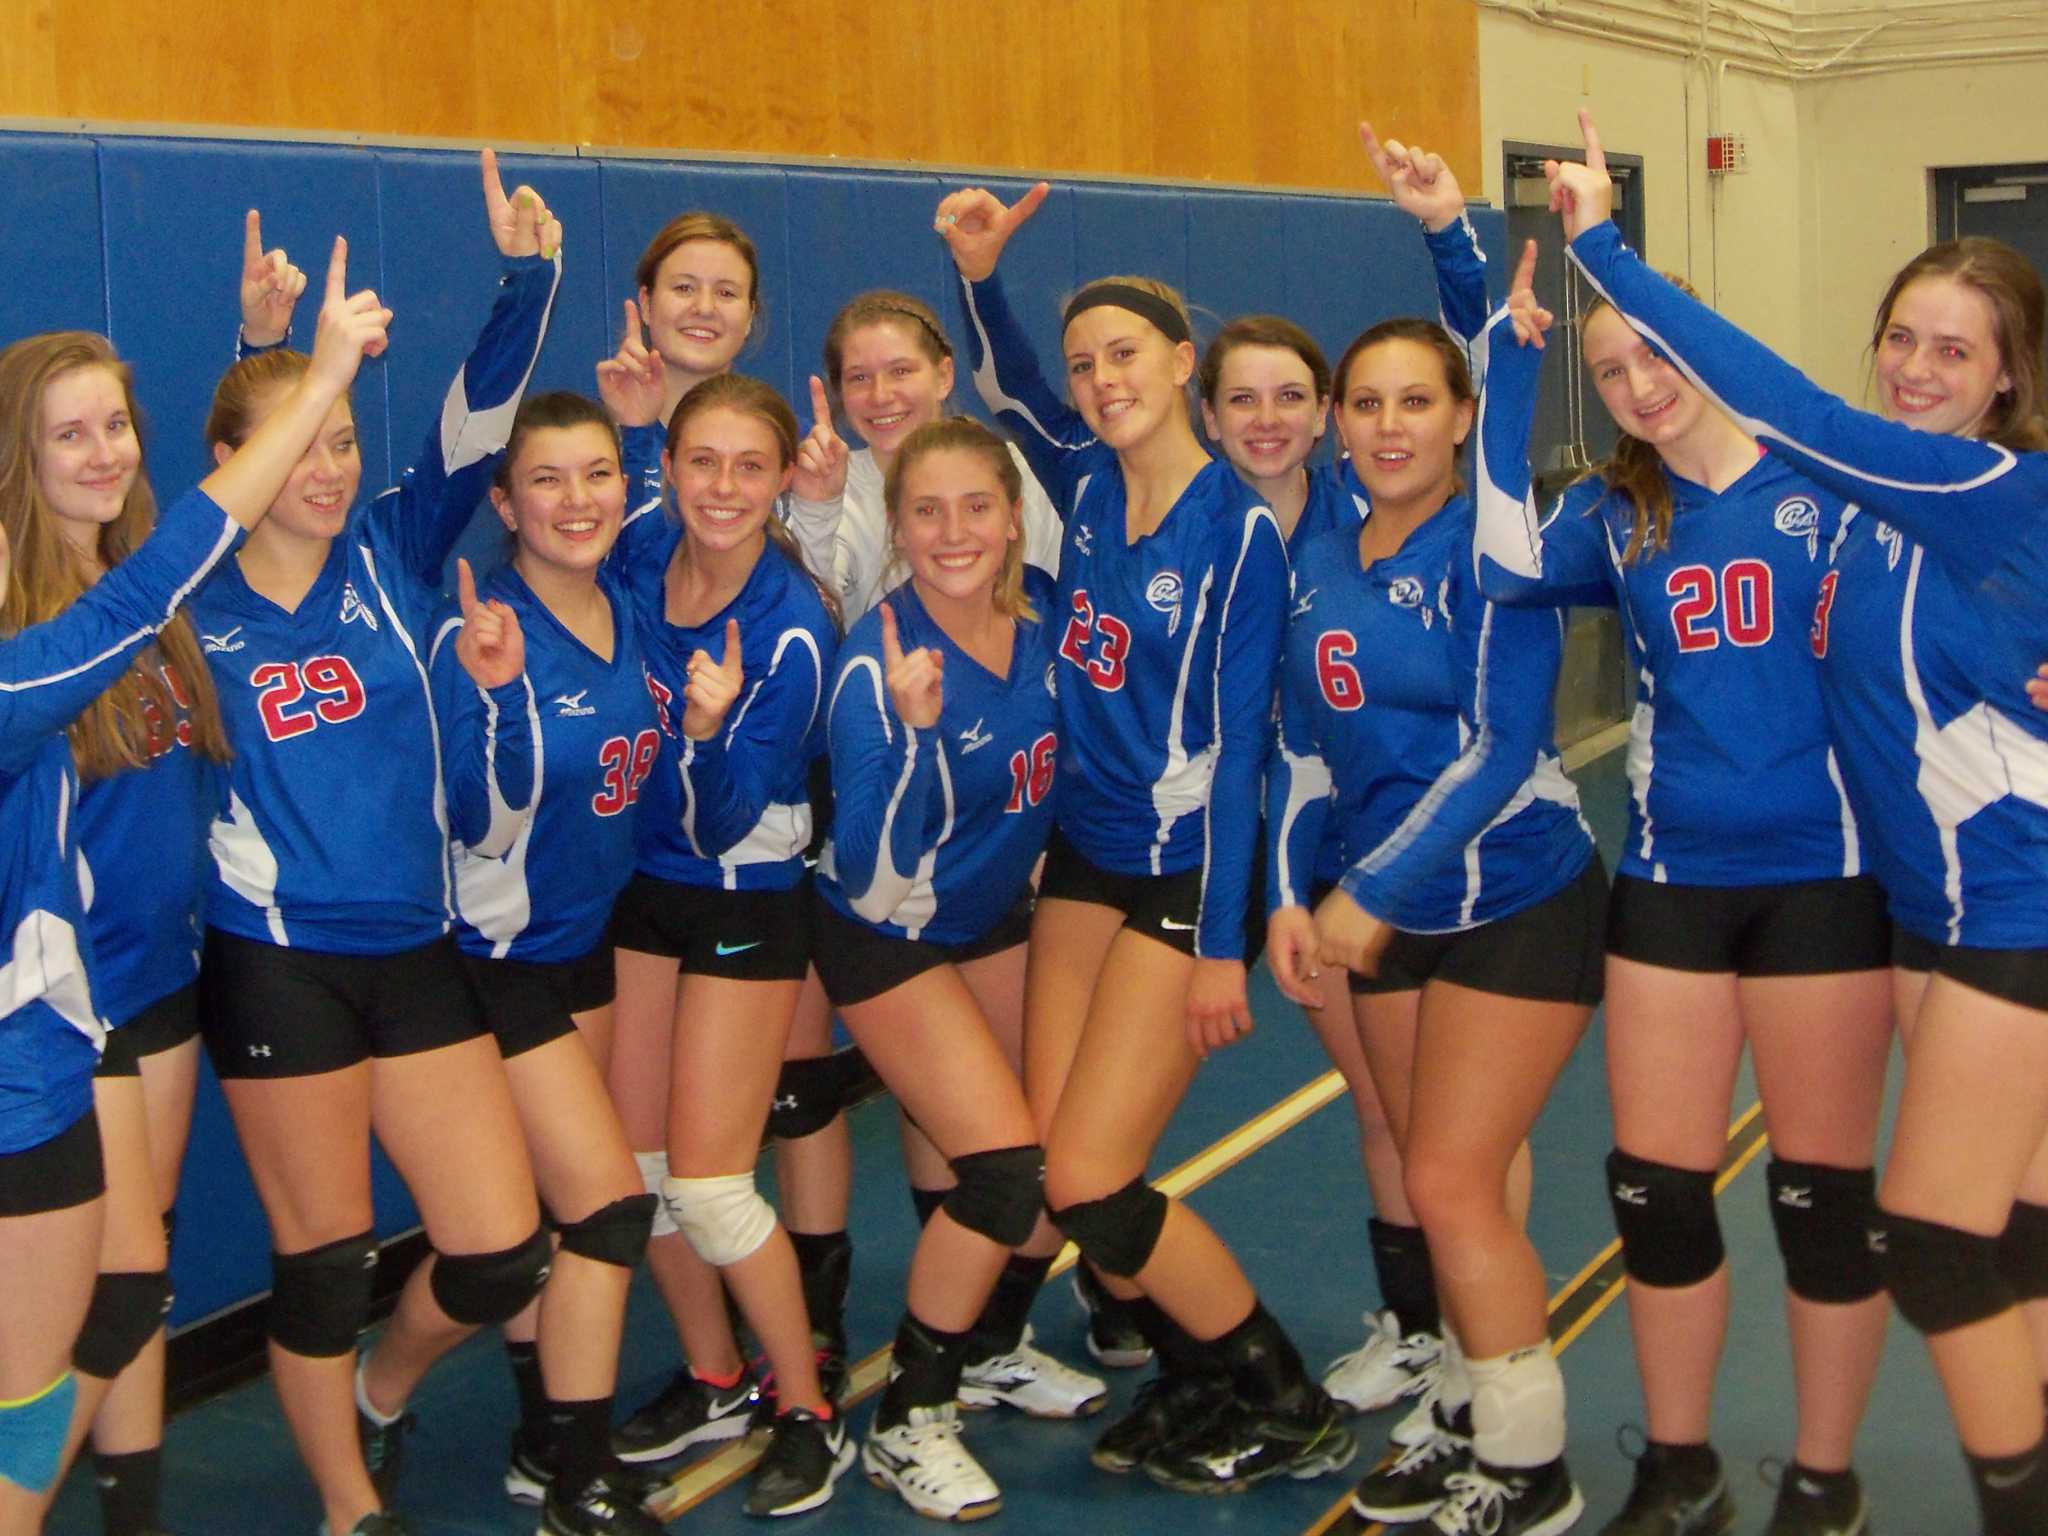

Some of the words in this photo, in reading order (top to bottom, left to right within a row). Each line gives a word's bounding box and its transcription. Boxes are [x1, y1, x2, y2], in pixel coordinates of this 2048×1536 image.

[1059, 589, 1131, 692] 23
[1666, 558, 1774, 653] 20
[249, 655, 367, 742] 29
[1315, 629, 1366, 712] 6
[592, 728, 660, 817] 38
[1003, 731, 1058, 814] 16
